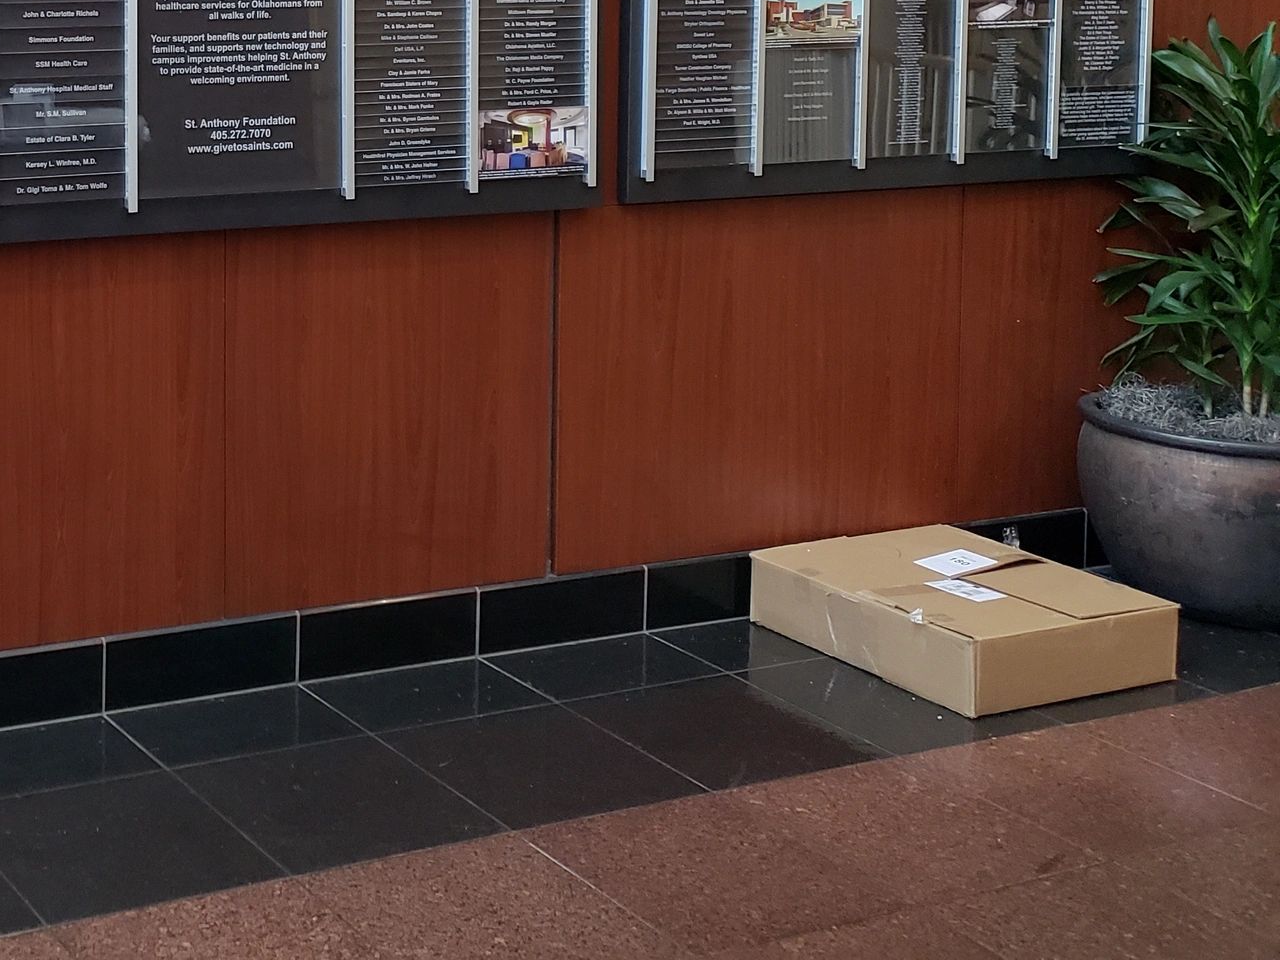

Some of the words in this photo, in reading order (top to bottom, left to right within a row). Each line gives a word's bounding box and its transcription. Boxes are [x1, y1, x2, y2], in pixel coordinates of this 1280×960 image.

[155, 1, 199, 10] healthcare
[201, 0, 236, 9] services
[237, 0, 250, 8] for
[251, 0, 302, 8] Oklahomans
[208, 11, 219, 20] all
[220, 11, 244, 19] walks
[246, 10, 255, 19] of
[256, 10, 271, 18] life.
[184, 119, 197, 129] St.
[199, 118, 240, 130] Anthony
[242, 115, 295, 126] Foundation
[210, 128, 270, 139] 405.272.7070
[187, 141, 293, 154] www.givetosaints.com
